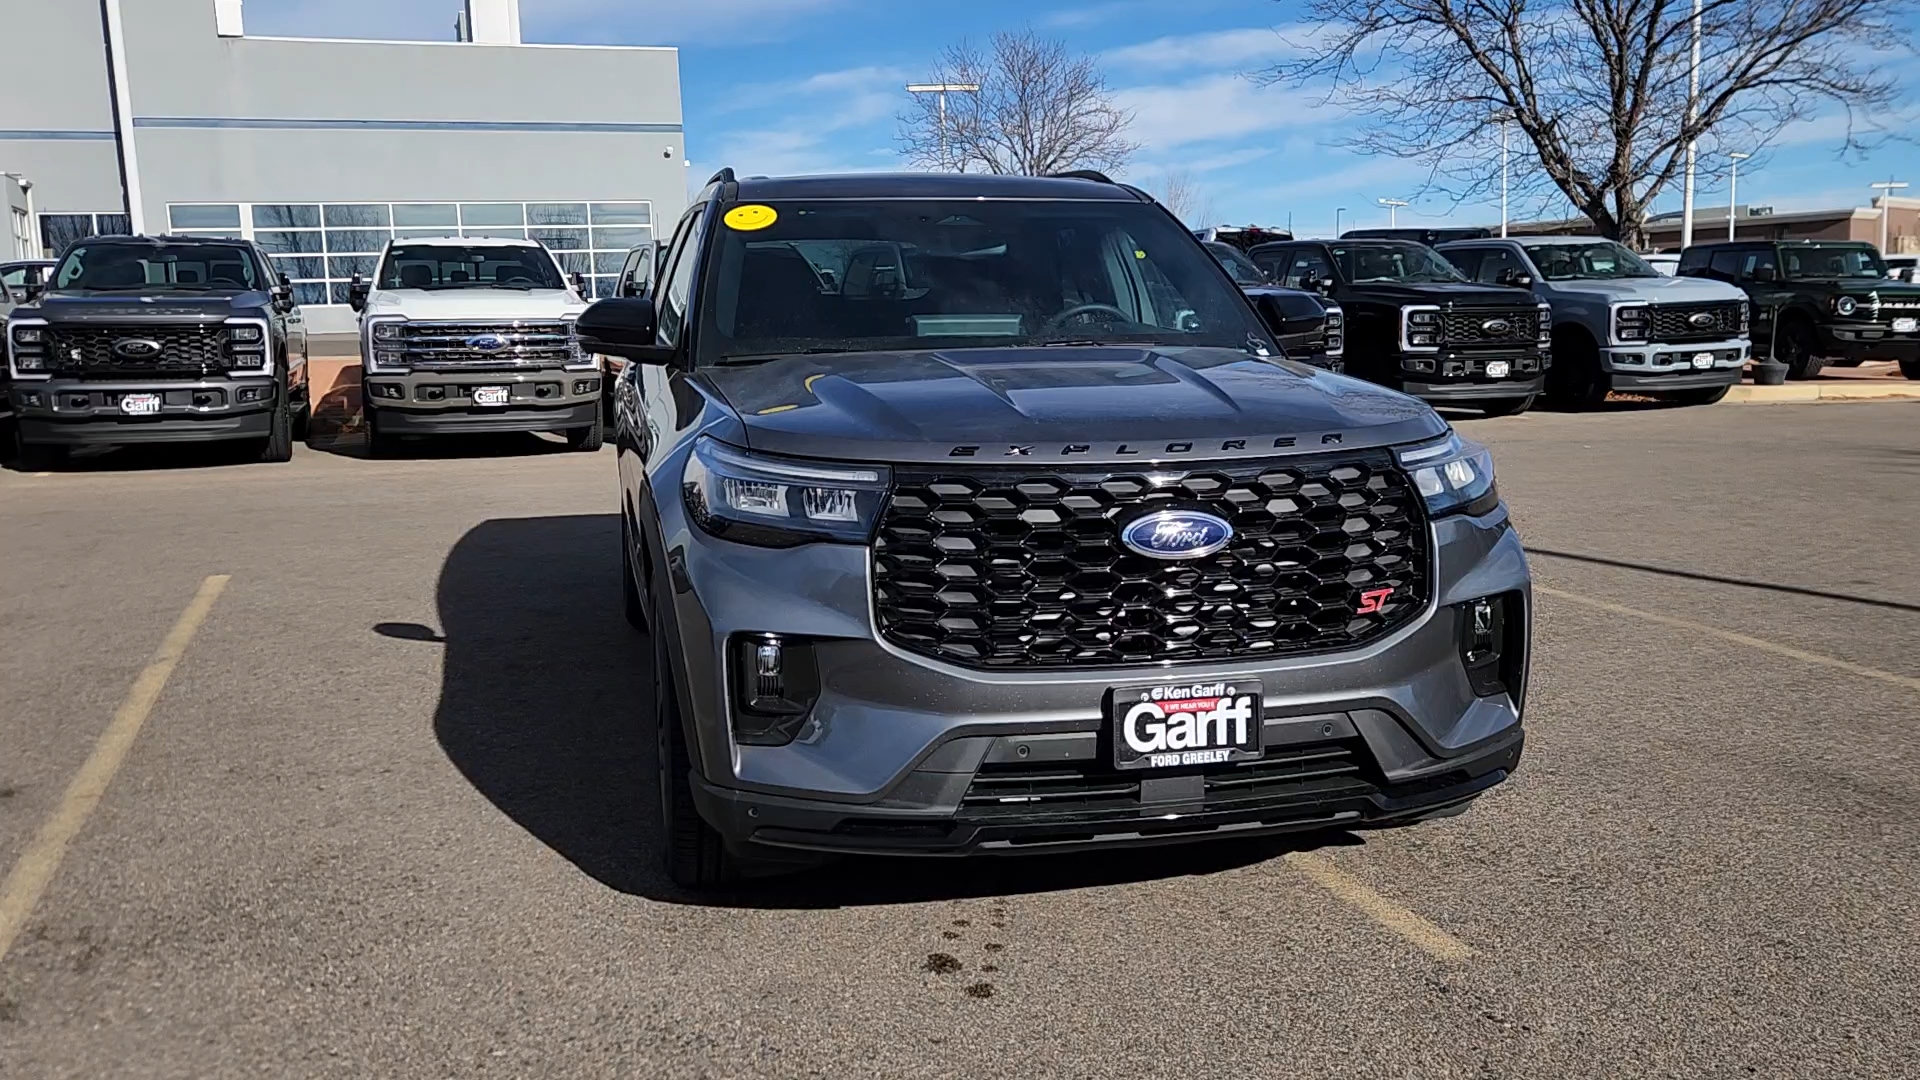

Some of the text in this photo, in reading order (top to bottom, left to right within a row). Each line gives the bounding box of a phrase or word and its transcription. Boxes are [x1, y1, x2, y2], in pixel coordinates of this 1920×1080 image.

[121, 396, 160, 412] Garff
[474, 389, 508, 404] Garff
[947, 433, 1344, 457] EXPLORER
[1150, 521, 1209, 548] Ford
[1356, 587, 1396, 614] ST
[1164, 686, 1190, 699] Ken
[1191, 683, 1225, 698] Garff
[1169, 701, 1211, 711] WE HEAR YOU
[1123, 696, 1252, 753] Garff
[1150, 750, 1230, 768] FORD GREELEY
